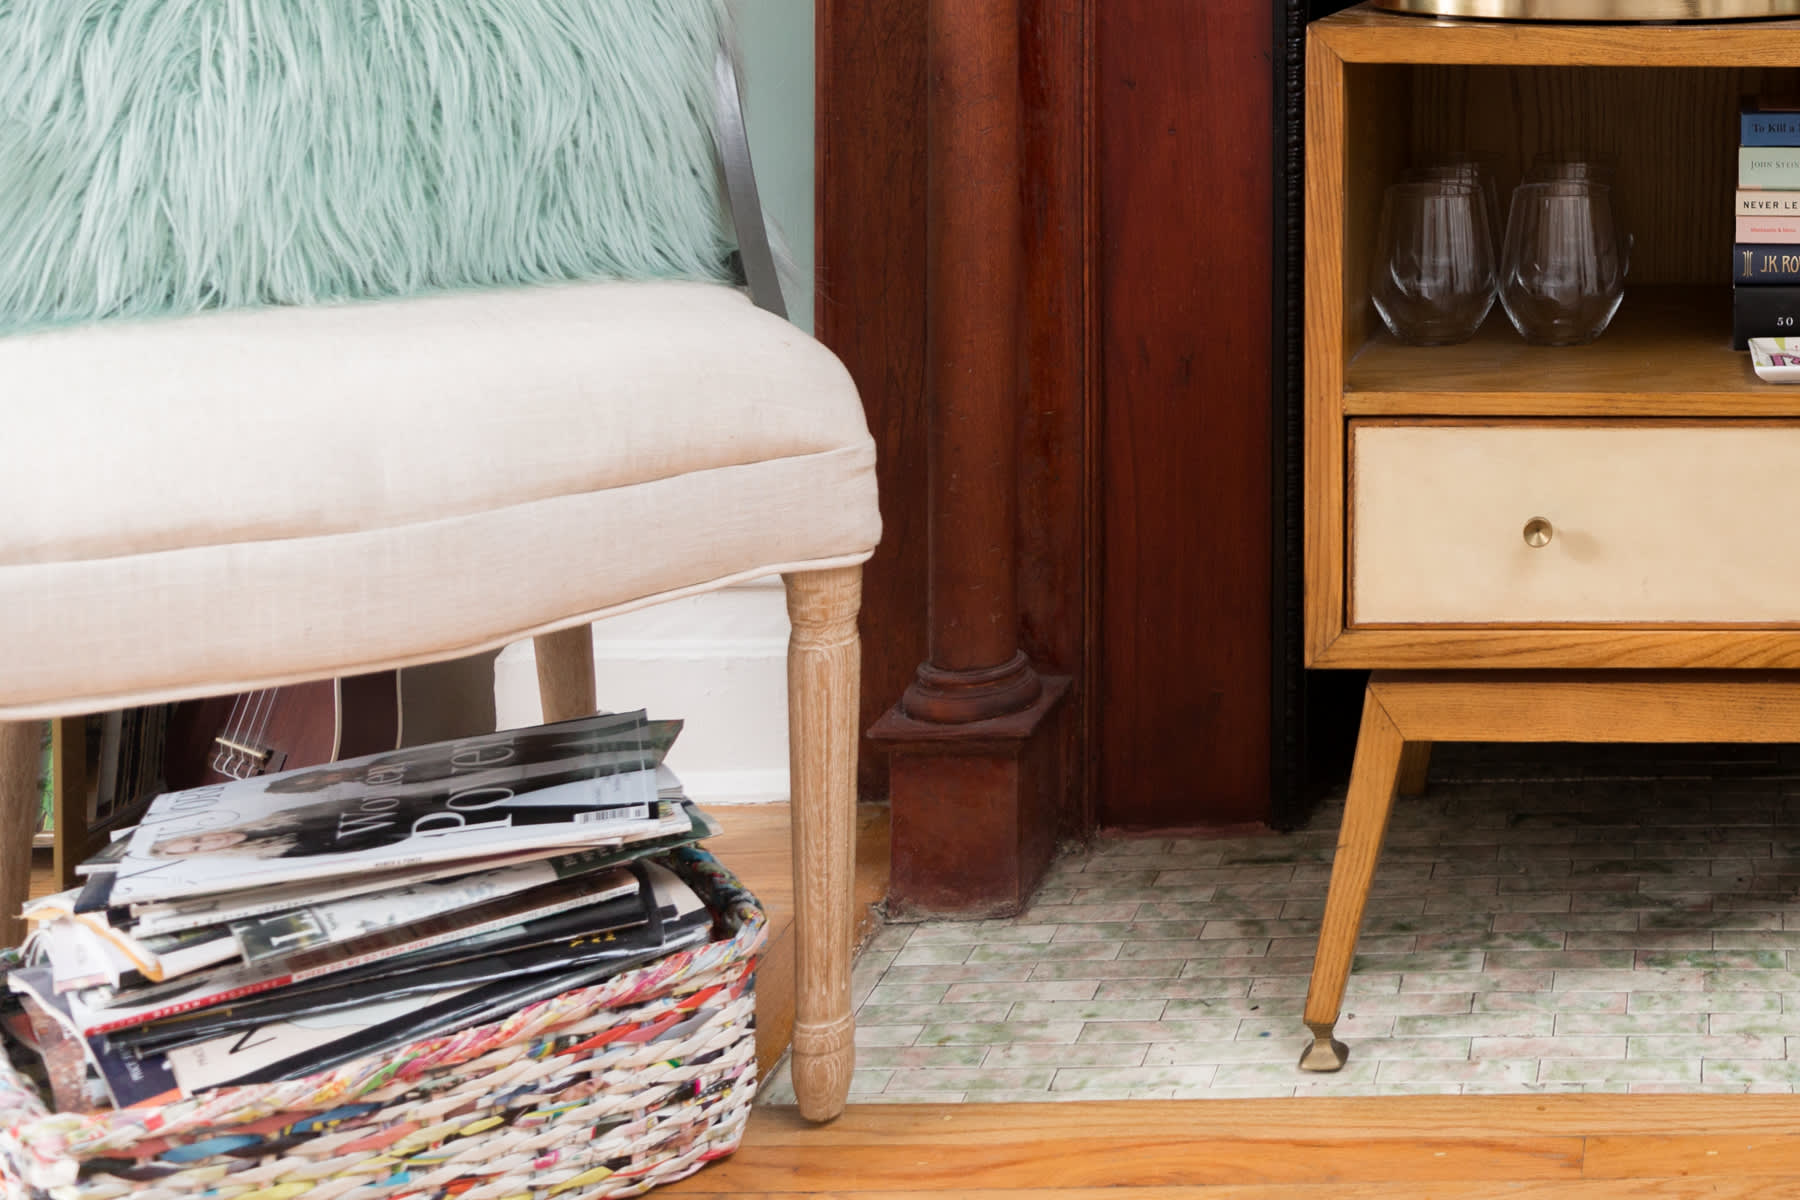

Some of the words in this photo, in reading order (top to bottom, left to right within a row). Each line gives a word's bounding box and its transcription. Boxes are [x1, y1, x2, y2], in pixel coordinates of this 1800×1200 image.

[1752, 123, 1765, 133] To
[1768, 122, 1787, 133] Kill
[1750, 160, 1773, 169] JOHN
[1743, 200, 1779, 209] NEVER
[1777, 316, 1794, 327] 50
[411, 736, 515, 838] Poer
[336, 762, 408, 840] Woen
